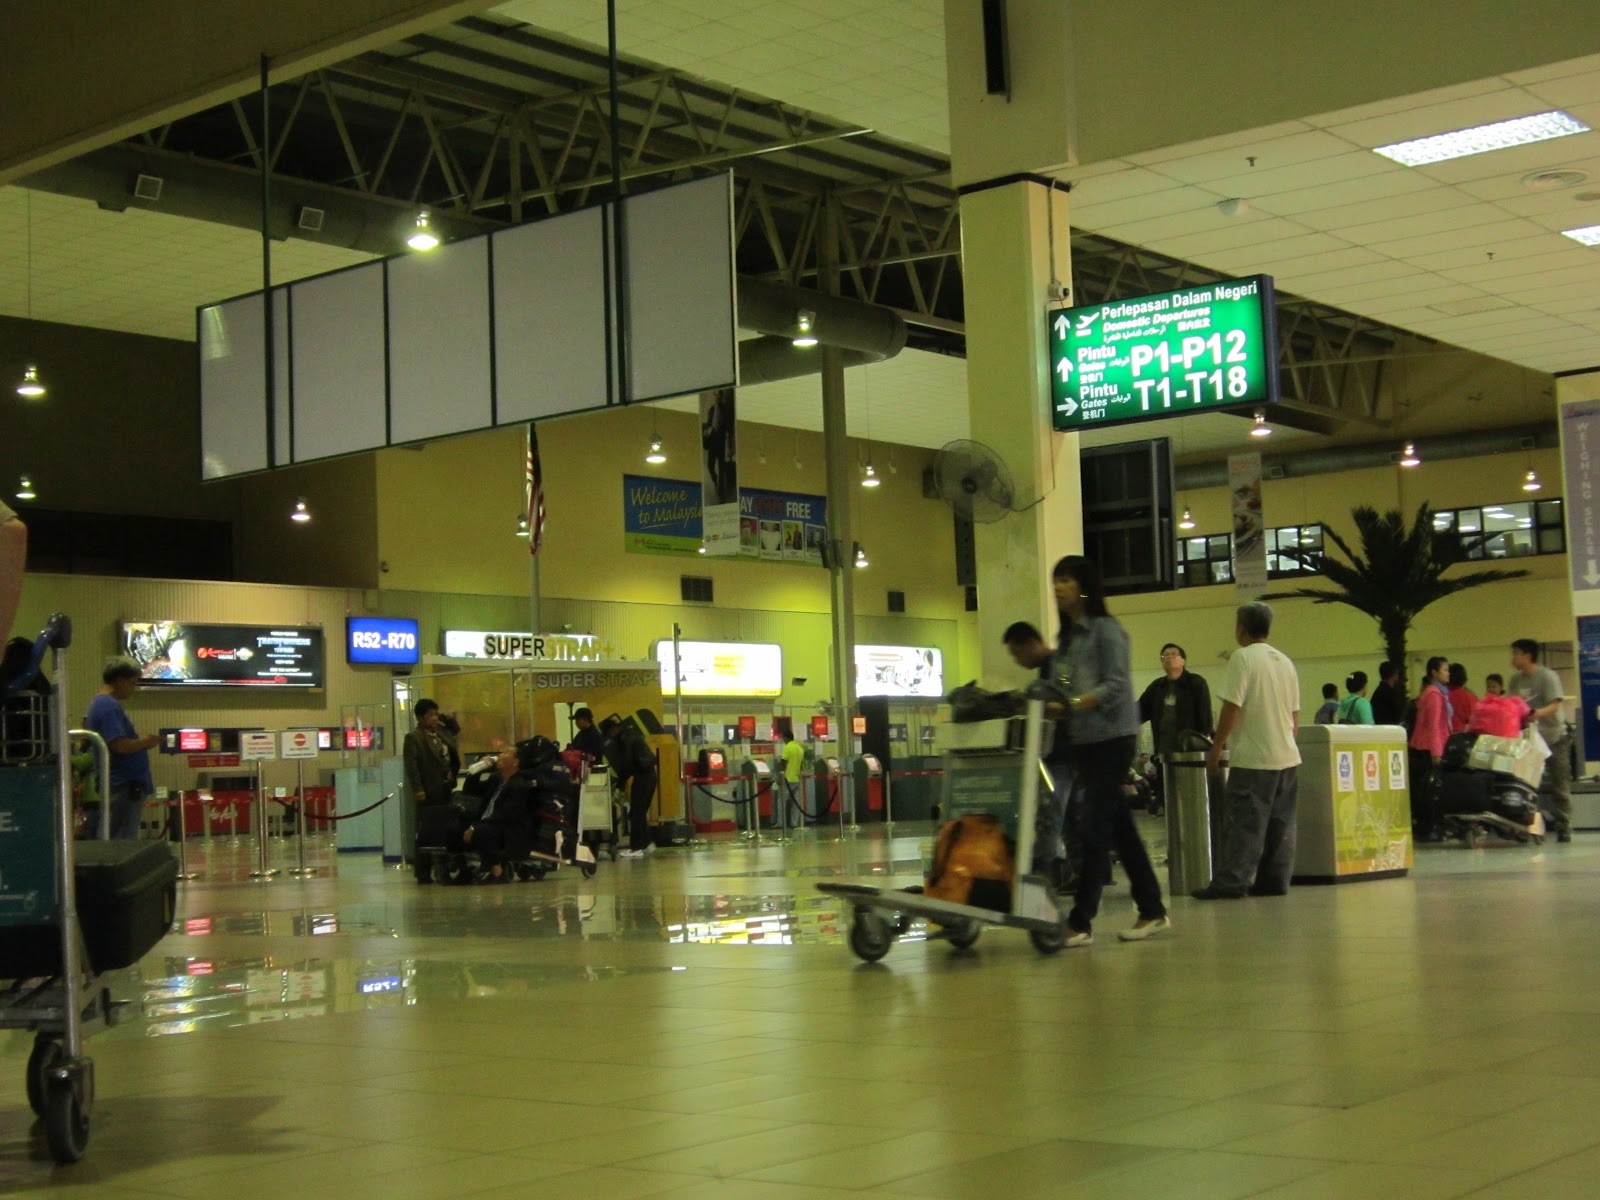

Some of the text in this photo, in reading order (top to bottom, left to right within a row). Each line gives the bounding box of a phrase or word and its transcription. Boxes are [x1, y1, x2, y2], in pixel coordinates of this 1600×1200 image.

[1102, 281, 1258, 320] Perlepasan Dalam Negeri
[1103, 306, 1211, 333] Domestic Departures
[1077, 344, 1117, 363] Pintu
[1131, 329, 1247, 377] P1-P12
[1078, 361, 1106, 373] Gates
[1080, 382, 1118, 400] Pintu
[1133, 365, 1248, 411] T1-T18
[1081, 398, 1108, 409] Gates
[1576, 422, 1592, 500] WEIGHING
[630, 486, 688, 507] Welcome
[740, 496, 754, 513] AY
[786, 502, 811, 519] FREE
[638, 509, 650, 525] to
[1583, 506, 1595, 555] SCALE
[353, 631, 416, 650] R52-R70
